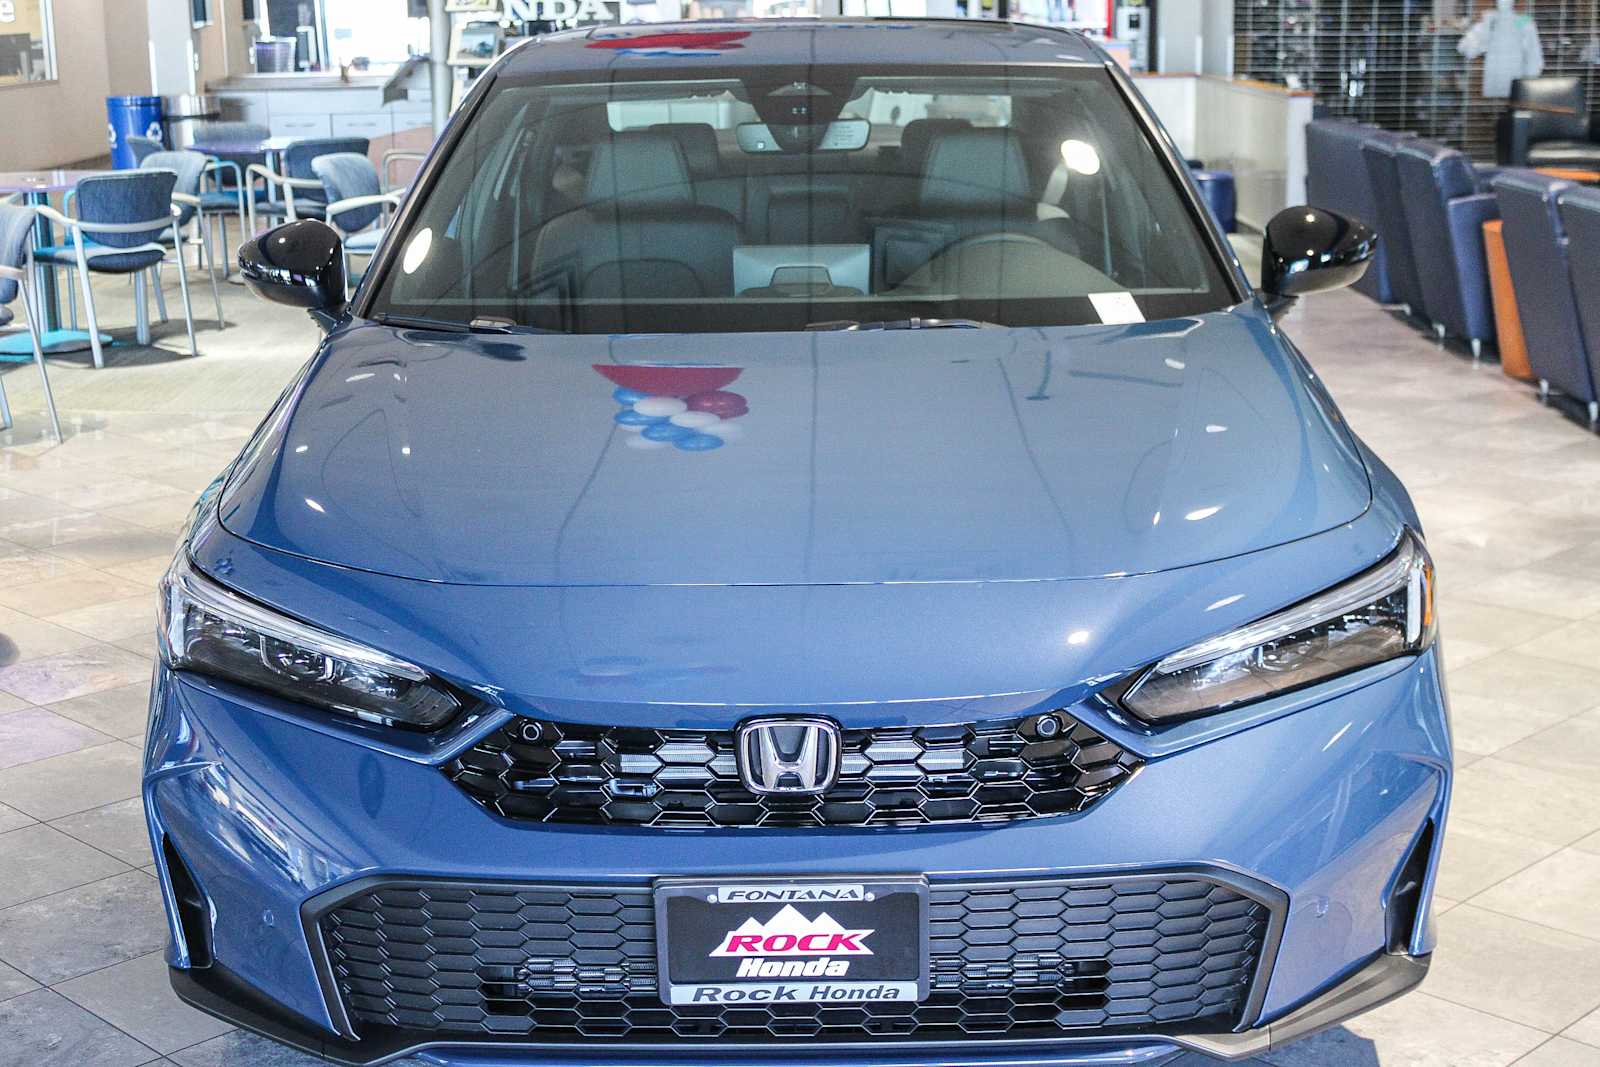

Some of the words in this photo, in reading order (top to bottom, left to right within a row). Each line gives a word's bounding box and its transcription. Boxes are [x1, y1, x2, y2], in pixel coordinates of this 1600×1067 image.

[726, 889, 860, 902] FONTANA
[725, 933, 862, 953] ROCK
[735, 957, 850, 978] Honda
[692, 986, 800, 1003] Rock
[808, 985, 900, 1001] Honda
